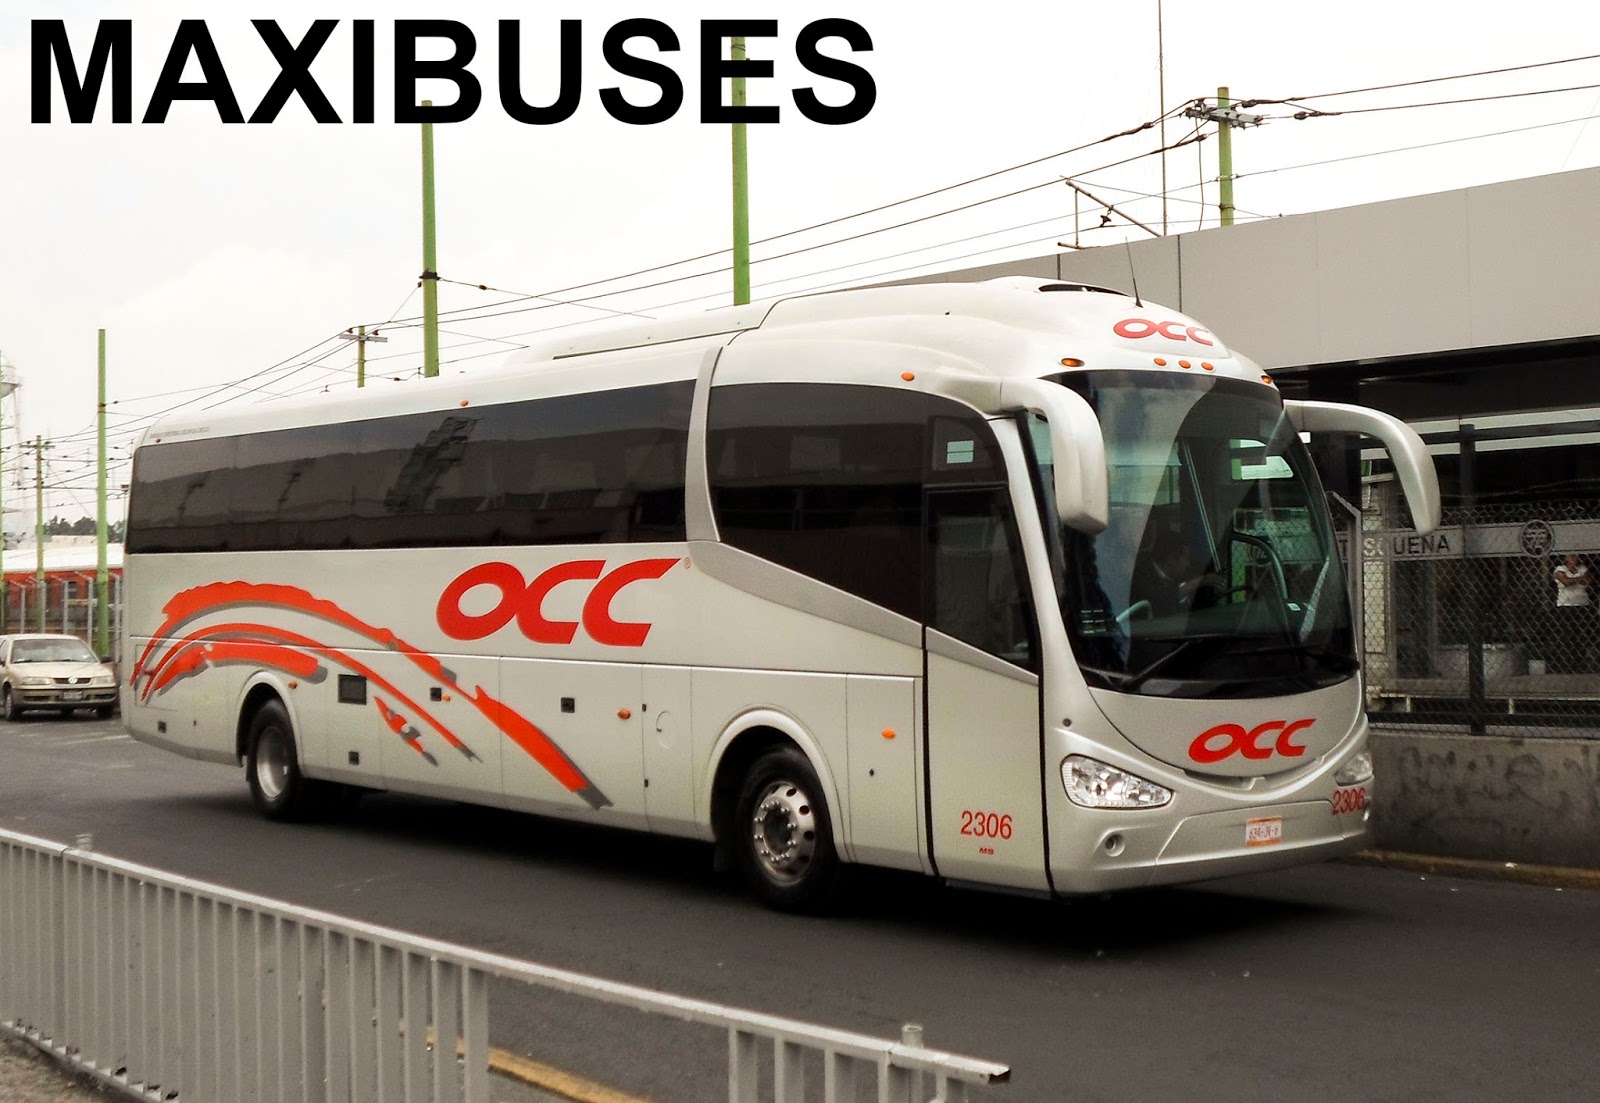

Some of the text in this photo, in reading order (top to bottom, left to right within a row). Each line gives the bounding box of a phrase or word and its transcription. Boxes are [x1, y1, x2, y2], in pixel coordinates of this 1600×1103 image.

[1113, 318, 1213, 346] OCC
[436, 558, 681, 647] OCC
[1189, 719, 1317, 764] OCC
[1332, 787, 1366, 815] 2306
[960, 810, 1012, 840] 2306
